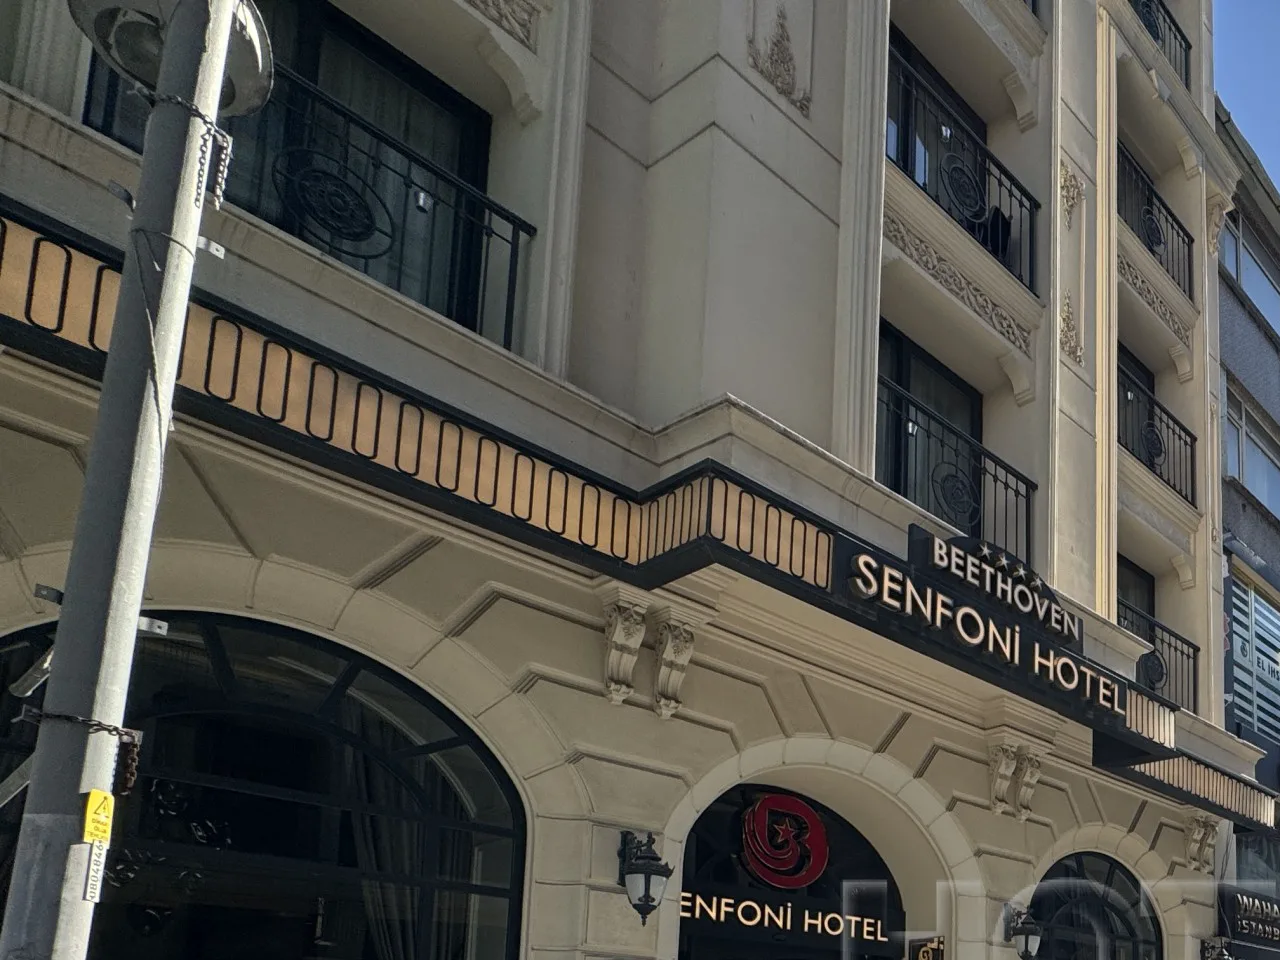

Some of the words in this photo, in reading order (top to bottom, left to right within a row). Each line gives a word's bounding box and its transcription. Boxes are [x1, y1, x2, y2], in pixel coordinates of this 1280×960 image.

[856, 553, 1020, 666] SENFONİ
[1034, 642, 1126, 716] HOTEL
[933, 537, 1080, 641] BEETHOVEN
[680, 891, 792, 931] ENFONİ
[803, 909, 889, 942] HOTEL
